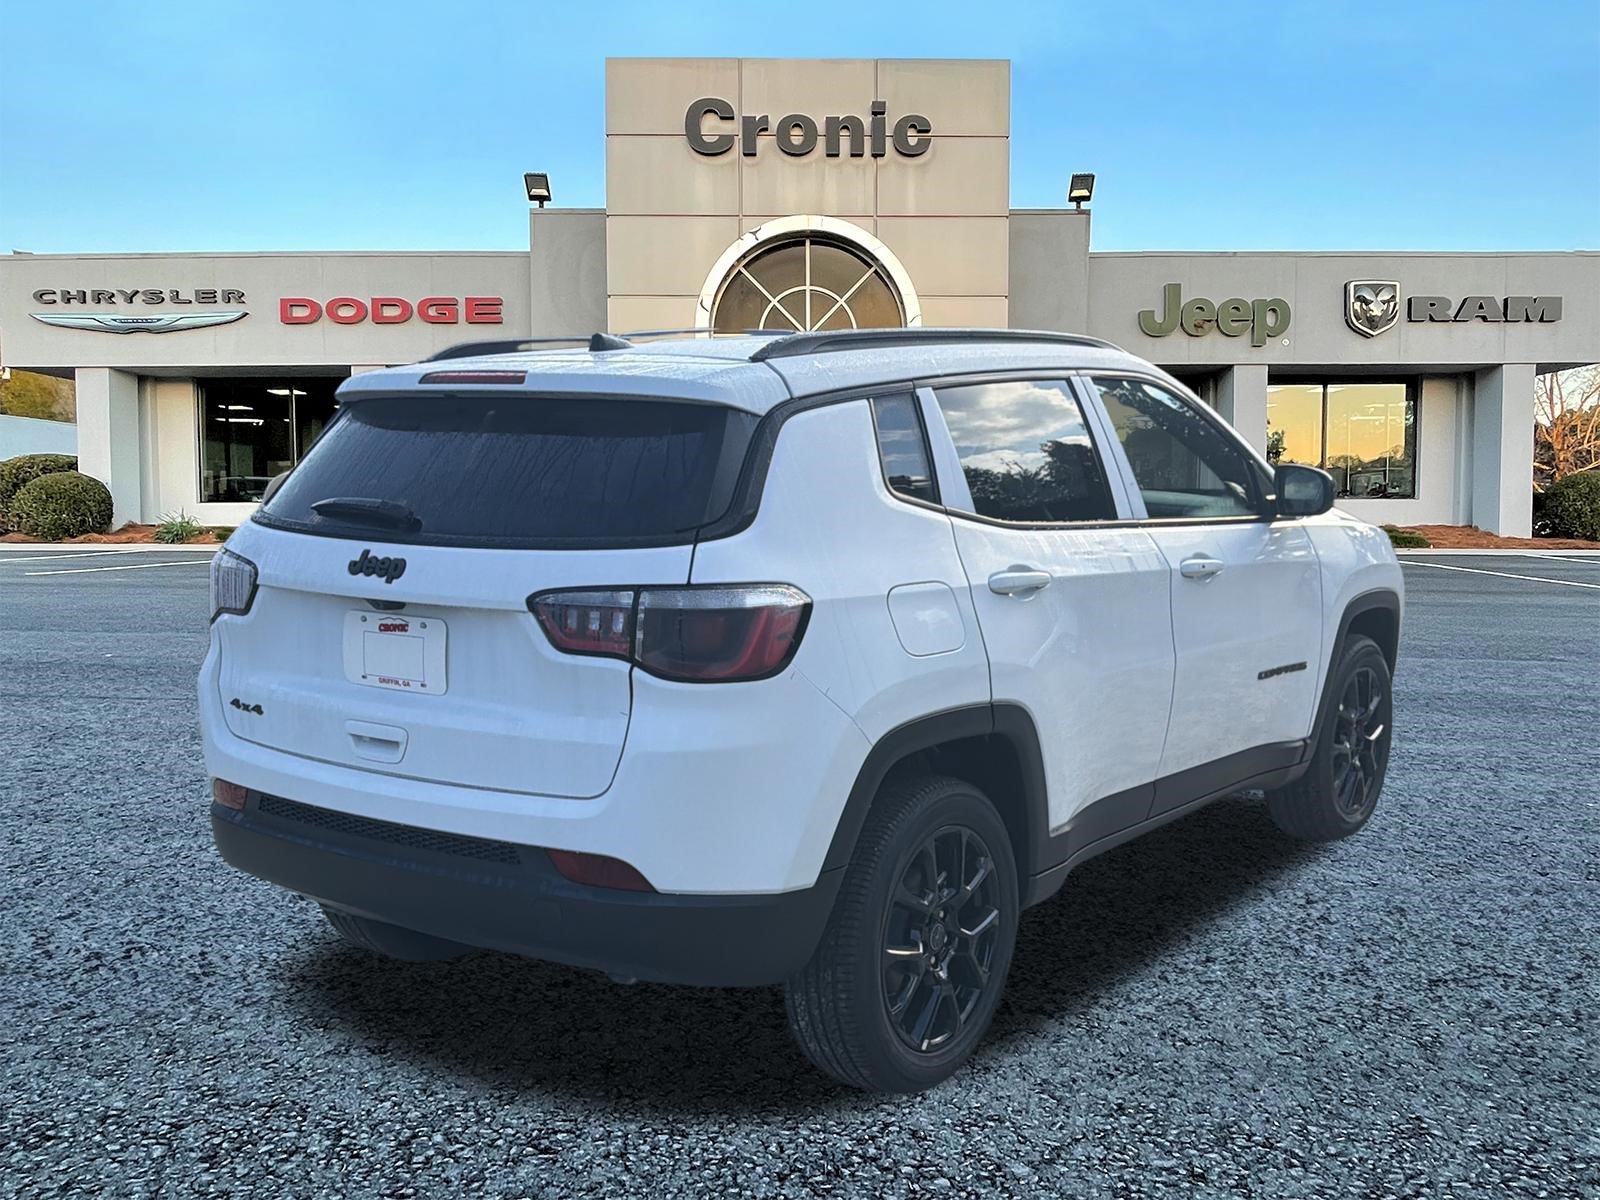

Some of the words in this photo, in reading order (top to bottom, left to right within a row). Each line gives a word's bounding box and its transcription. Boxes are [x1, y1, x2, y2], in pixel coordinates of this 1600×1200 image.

[685, 97, 932, 157] Cronic
[32, 289, 247, 304] CHRYSLER
[280, 296, 504, 325] DODGE
[1407, 296, 1563, 323] RAM
[1138, 283, 1291, 346] Jeep
[348, 549, 407, 584] Jeep
